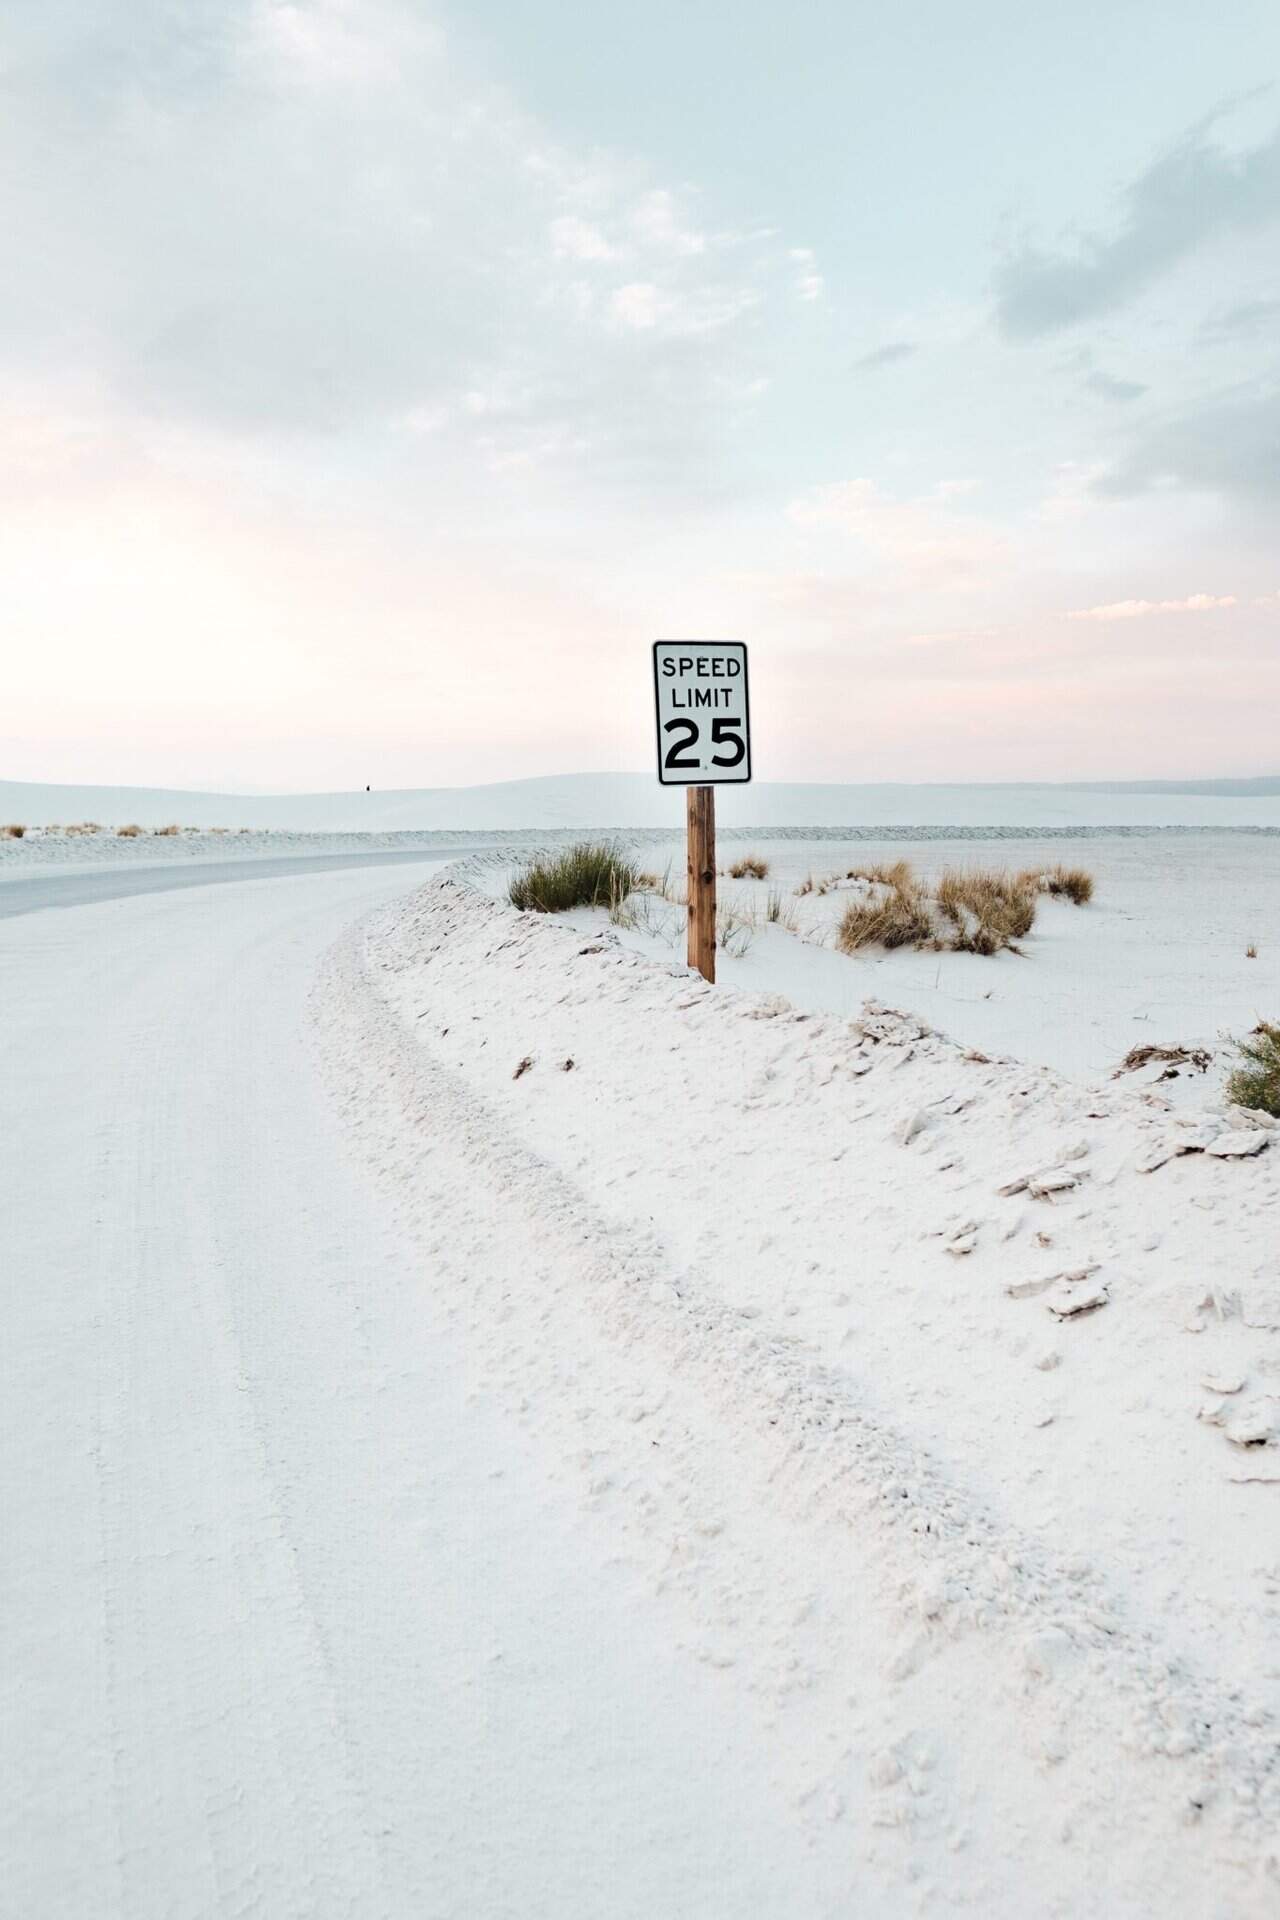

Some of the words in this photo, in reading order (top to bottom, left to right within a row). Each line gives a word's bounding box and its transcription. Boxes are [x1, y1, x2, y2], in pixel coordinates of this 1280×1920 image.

[662, 657, 741, 677] SPEED
[672, 688, 733, 707] LIMIT
[664, 717, 746, 768] 25
